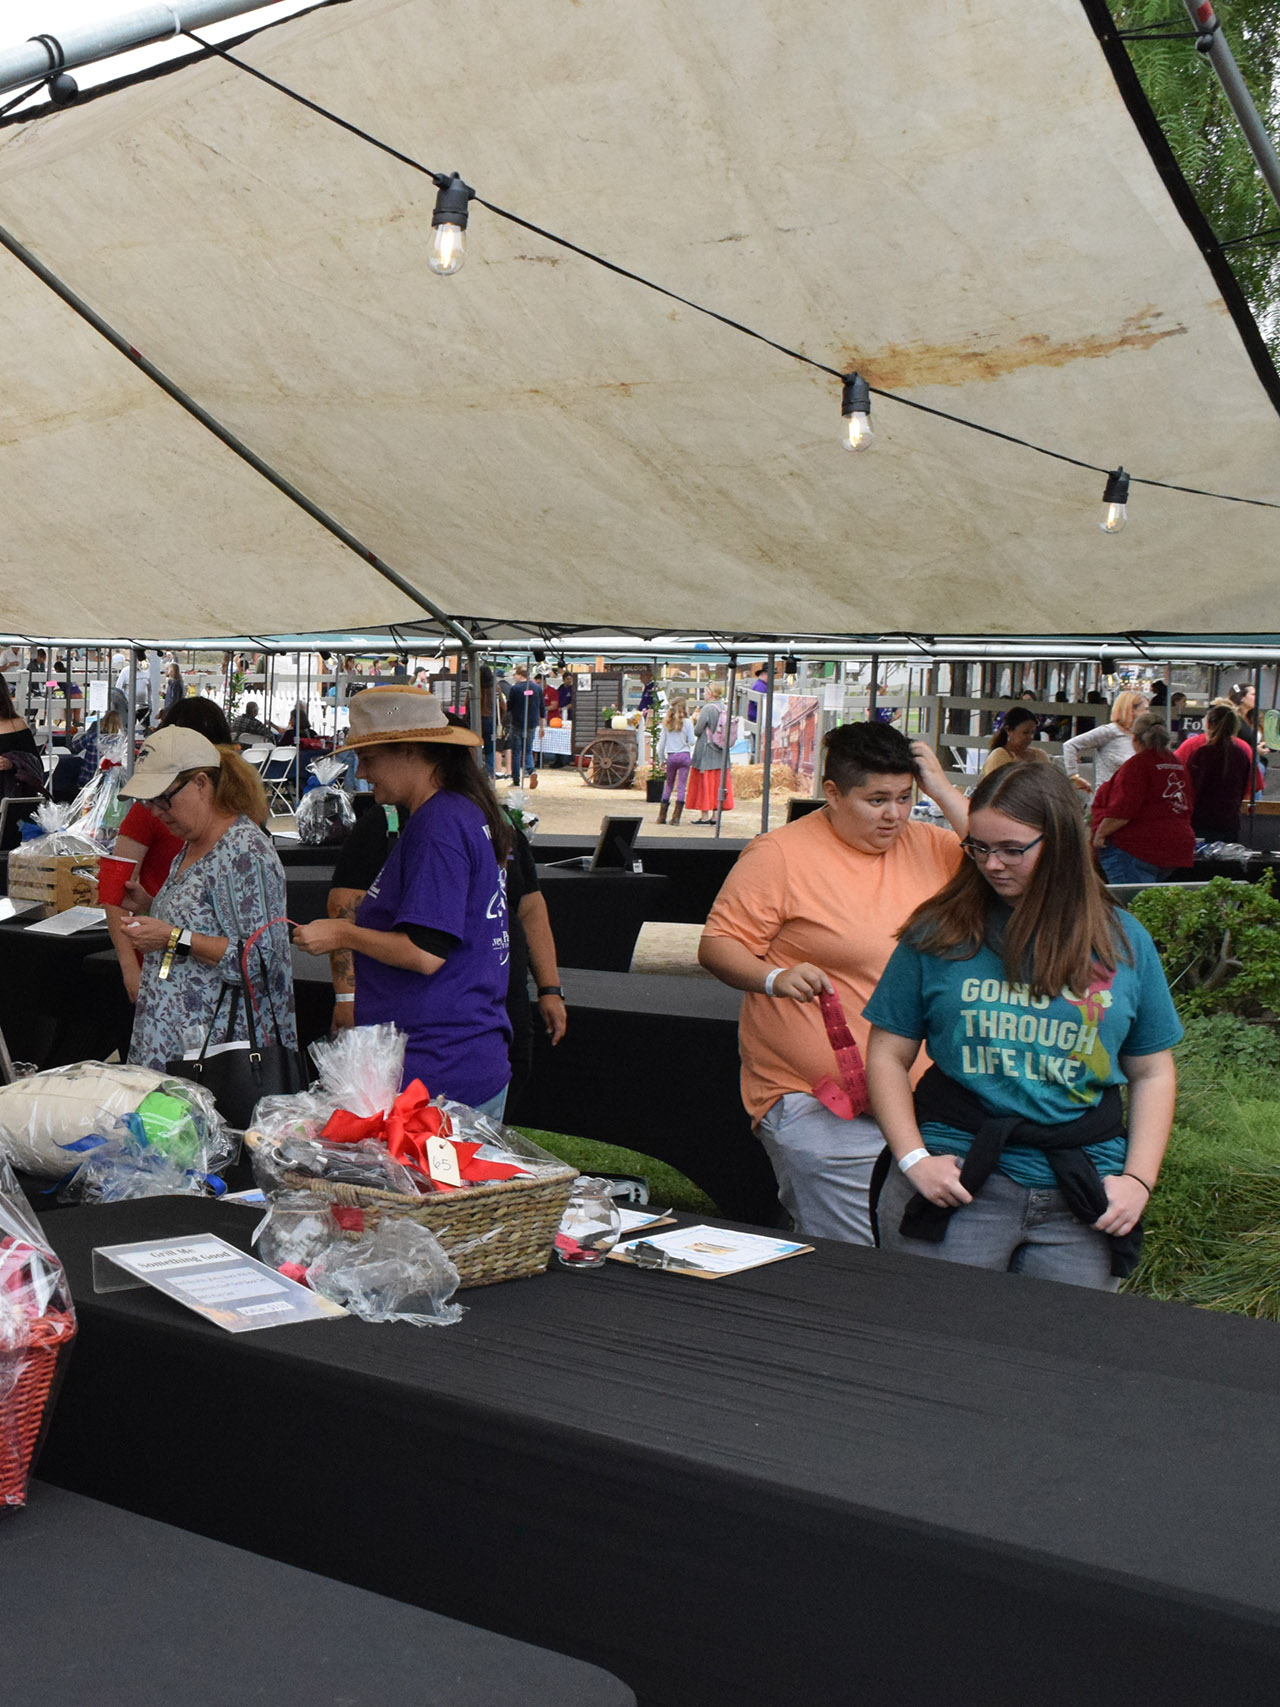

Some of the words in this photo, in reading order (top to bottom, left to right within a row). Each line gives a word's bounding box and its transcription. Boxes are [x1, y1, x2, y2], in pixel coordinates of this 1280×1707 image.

[960, 1009, 1098, 1055] THROUGH
[962, 1045, 1019, 1077] LIFE
[1024, 1051, 1082, 1089] LIKE
[432, 1156, 452, 1171] 65
[137, 1253, 199, 1269] Something
[200, 1251, 231, 1263] Good
[150, 1249, 178, 1259] Grill
[179, 1247, 197, 1256] Me
